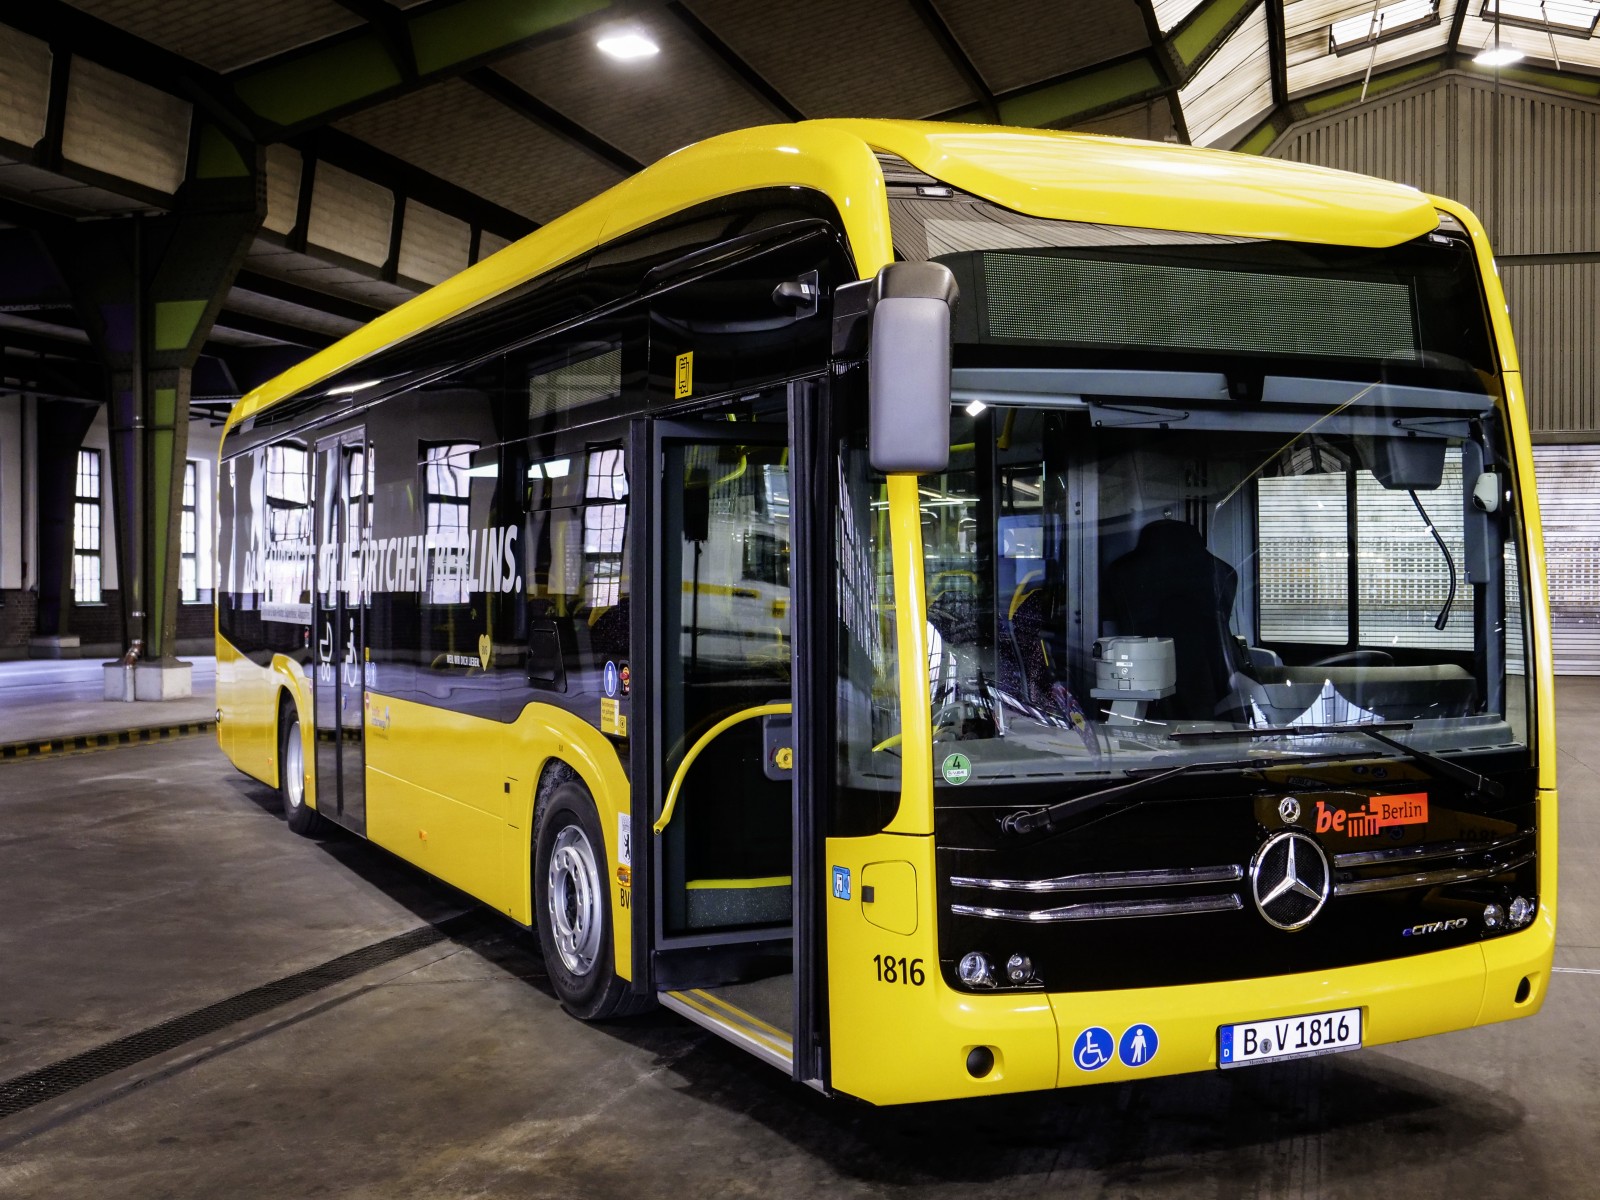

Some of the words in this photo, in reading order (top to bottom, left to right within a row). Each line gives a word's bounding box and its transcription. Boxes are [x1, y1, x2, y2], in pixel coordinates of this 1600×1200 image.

[359, 528, 428, 593] ÖRTCHEN
[433, 525, 522, 593] BERLINS.
[952, 755, 961, 769] 4
[1315, 800, 1347, 833] be
[1382, 802, 1422, 820] Berlin
[620, 888, 631, 910] BV
[873, 954, 926, 987] 1816
[1223, 1048, 1230, 1057] D
[1243, 1028, 1258, 1056] B
